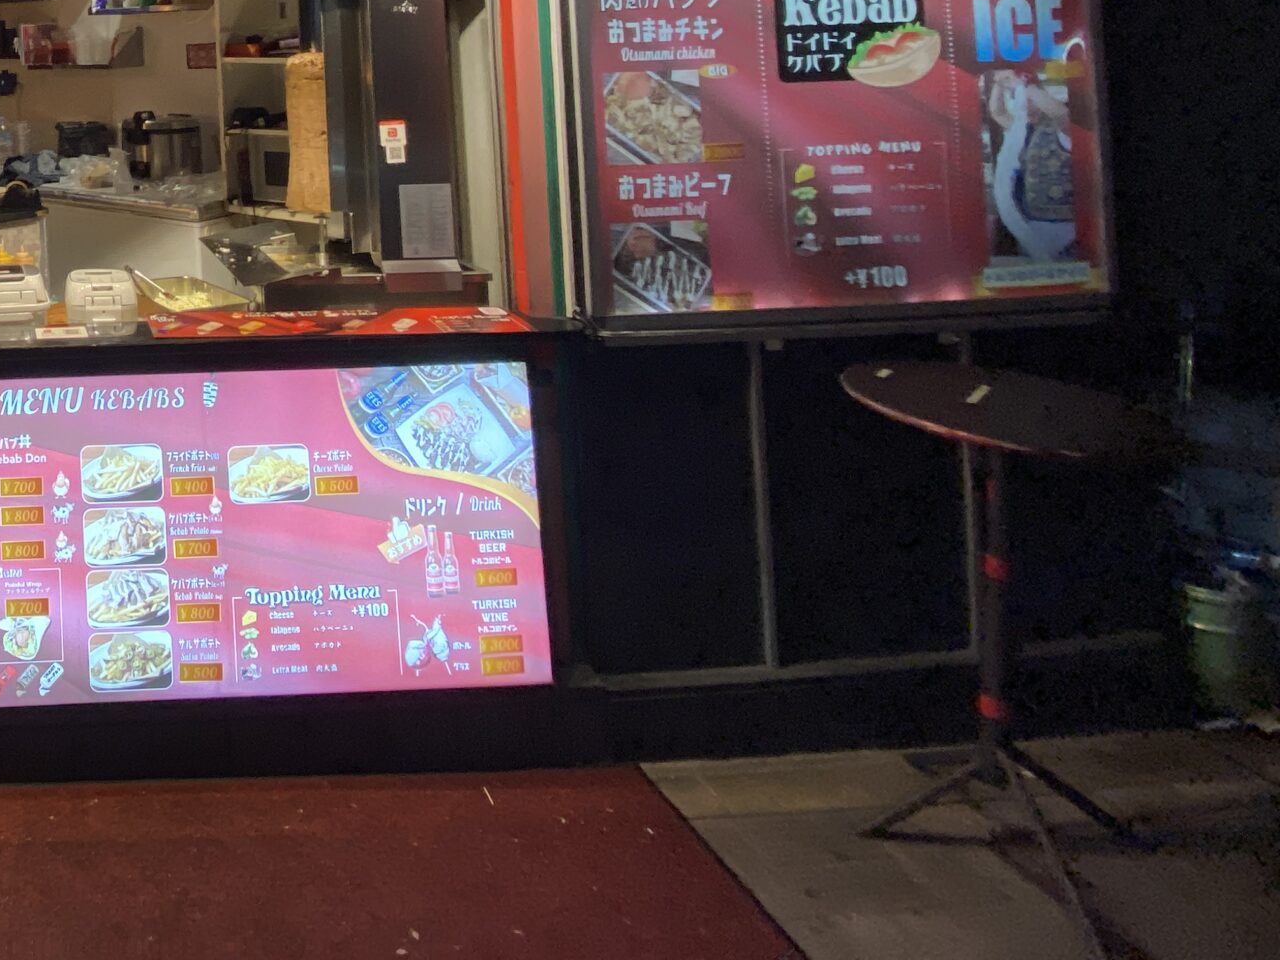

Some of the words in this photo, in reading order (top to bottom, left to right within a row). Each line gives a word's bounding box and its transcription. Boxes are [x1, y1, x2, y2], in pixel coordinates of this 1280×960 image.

[607, 16, 723, 43] おつまみチキン
[787, 32, 856, 52] ドイドイ
[618, 172, 731, 200] おつまみビーフ
[0, 386, 84, 416] MENU
[91, 387, 185, 410] KEBABS
[25, 453, 47, 463] Don
[405, 496, 447, 518] ドリンク
[470, 496, 502, 511] Drink
[469, 530, 514, 540] TURKISH
[479, 543, 506, 553] BEER
[245, 585, 323, 607] Topping
[329, 584, 381, 600] Menu
[351, 603, 389, 617] +¥100
[472, 599, 517, 610] TURKISH
[482, 612, 508, 622] WINE
